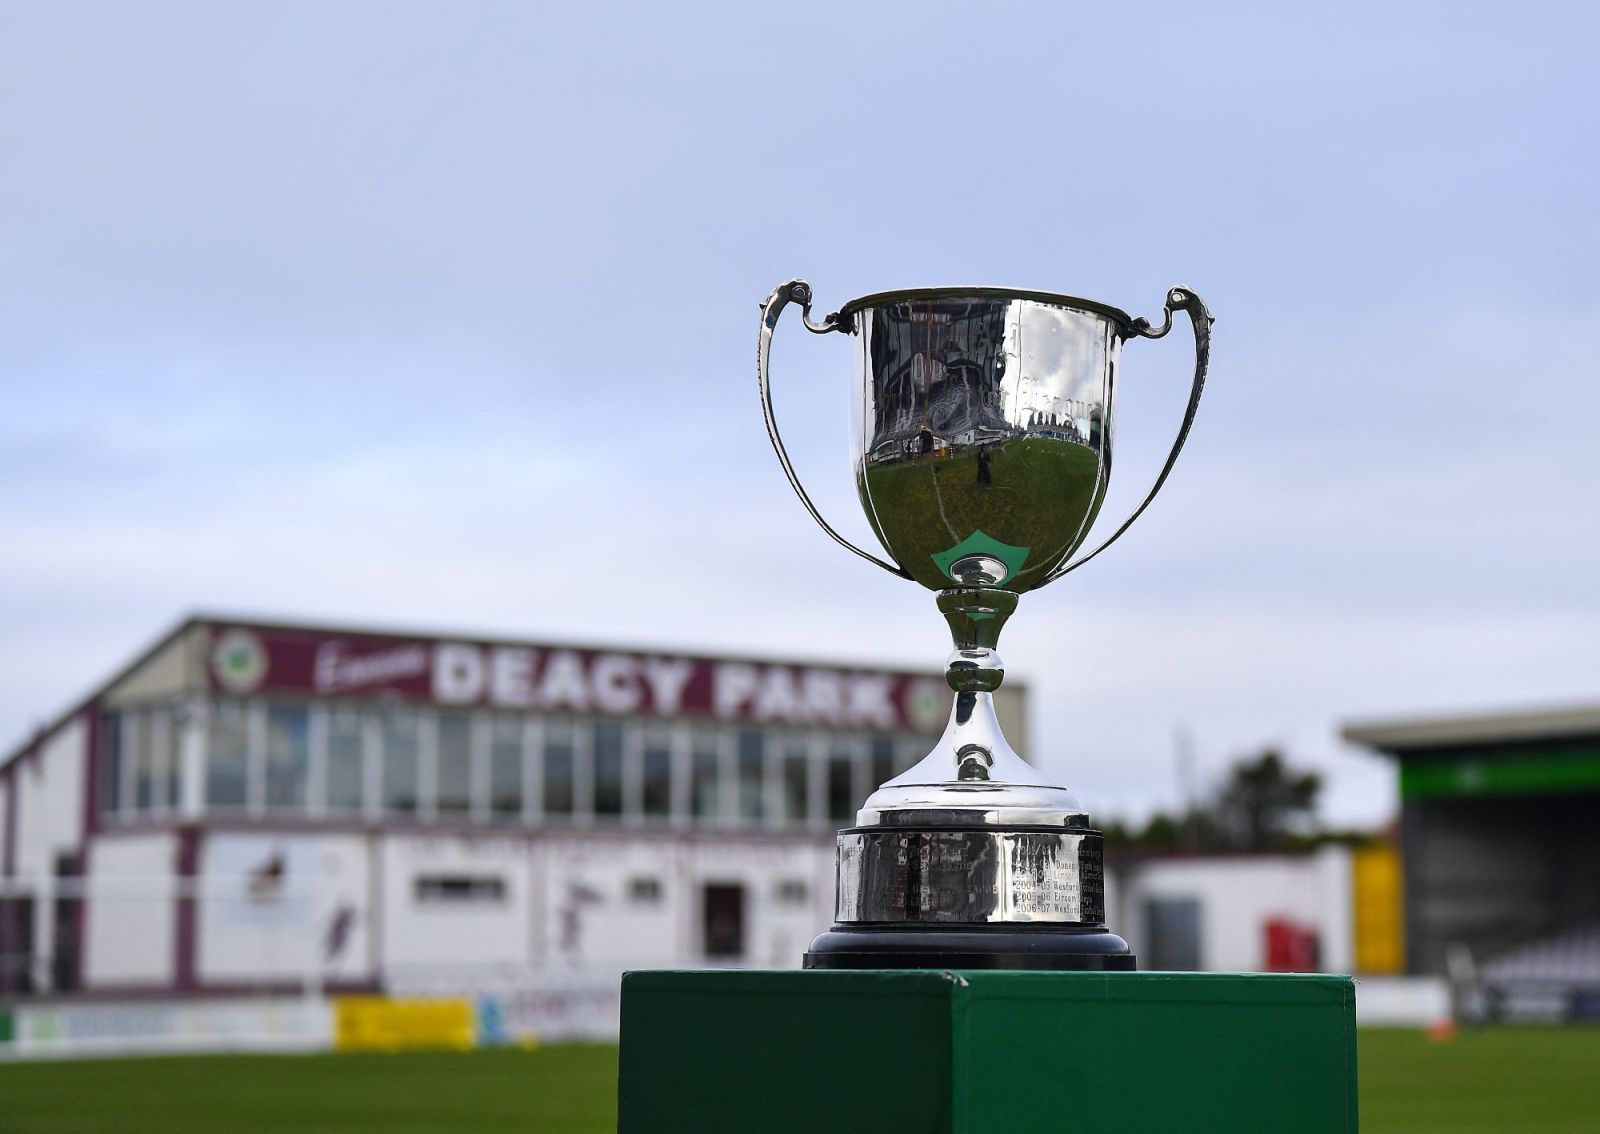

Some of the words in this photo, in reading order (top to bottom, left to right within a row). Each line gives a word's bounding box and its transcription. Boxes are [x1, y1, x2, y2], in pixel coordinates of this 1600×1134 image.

[432, 643, 695, 714] DEACY
[713, 663, 899, 726] PARK
[1016, 903, 1051, 913] 2006-07
